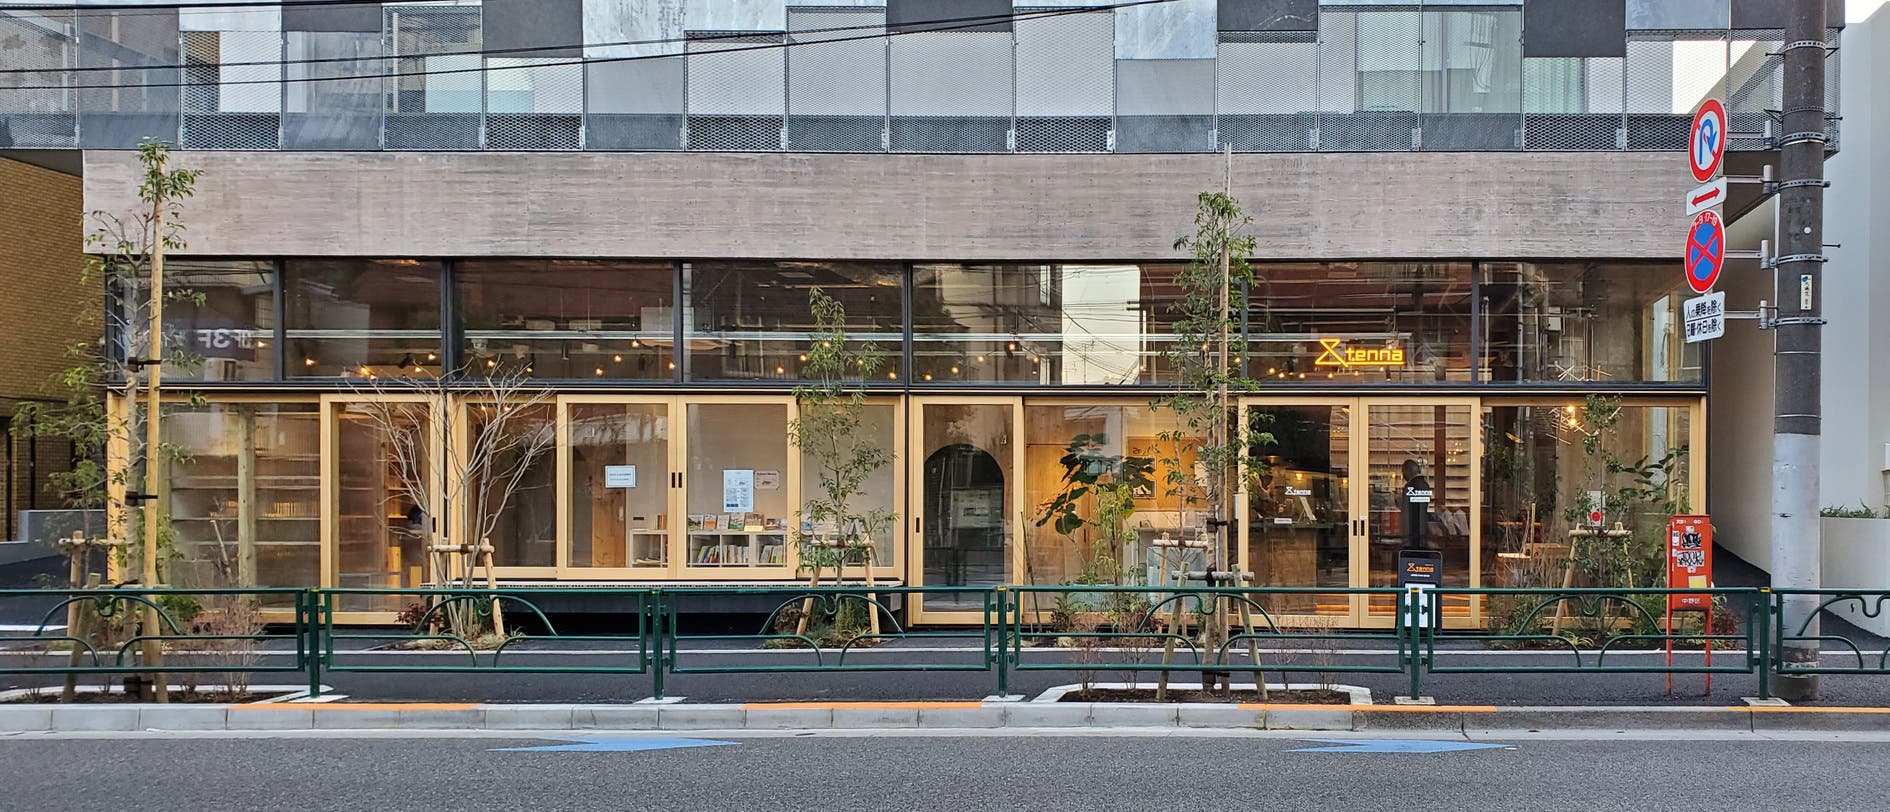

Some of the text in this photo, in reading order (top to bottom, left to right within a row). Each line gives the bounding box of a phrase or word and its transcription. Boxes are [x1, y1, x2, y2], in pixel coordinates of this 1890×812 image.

[1686, 300, 1722, 320] 人の乗降を除く
